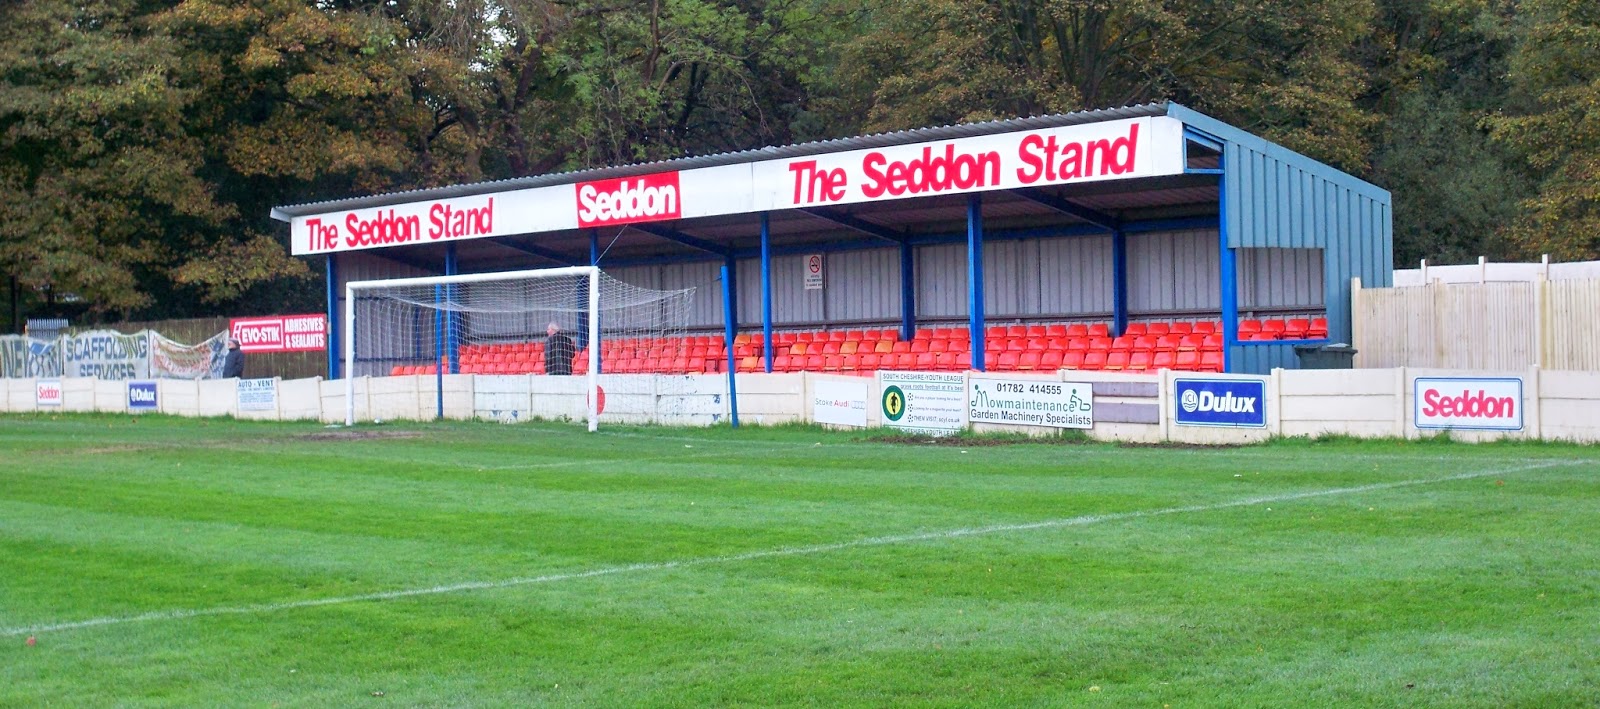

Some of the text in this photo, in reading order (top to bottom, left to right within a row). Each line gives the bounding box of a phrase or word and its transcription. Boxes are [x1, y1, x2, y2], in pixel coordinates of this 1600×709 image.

[789, 123, 1140, 204] The Seddon Stand
[578, 178, 676, 223] Seddon
[306, 198, 494, 251] The Seddon Stand
[285, 317, 324, 333] ADHESIVES
[66, 335, 147, 362] SCAFFOLDING
[285, 333, 324, 348] & SEALANTS
[238, 380, 252, 388] AUTO
[996, 383, 1062, 394] 01782 414555
[39, 386, 59, 399] Seddon
[136, 388, 155, 401] Dulux
[815, 398, 850, 407] Stoke Audi
[1198, 391, 1256, 413] Dulux
[1422, 388, 1514, 418] Seddon
[970, 409, 1091, 425] Garden Machinery Specialists
